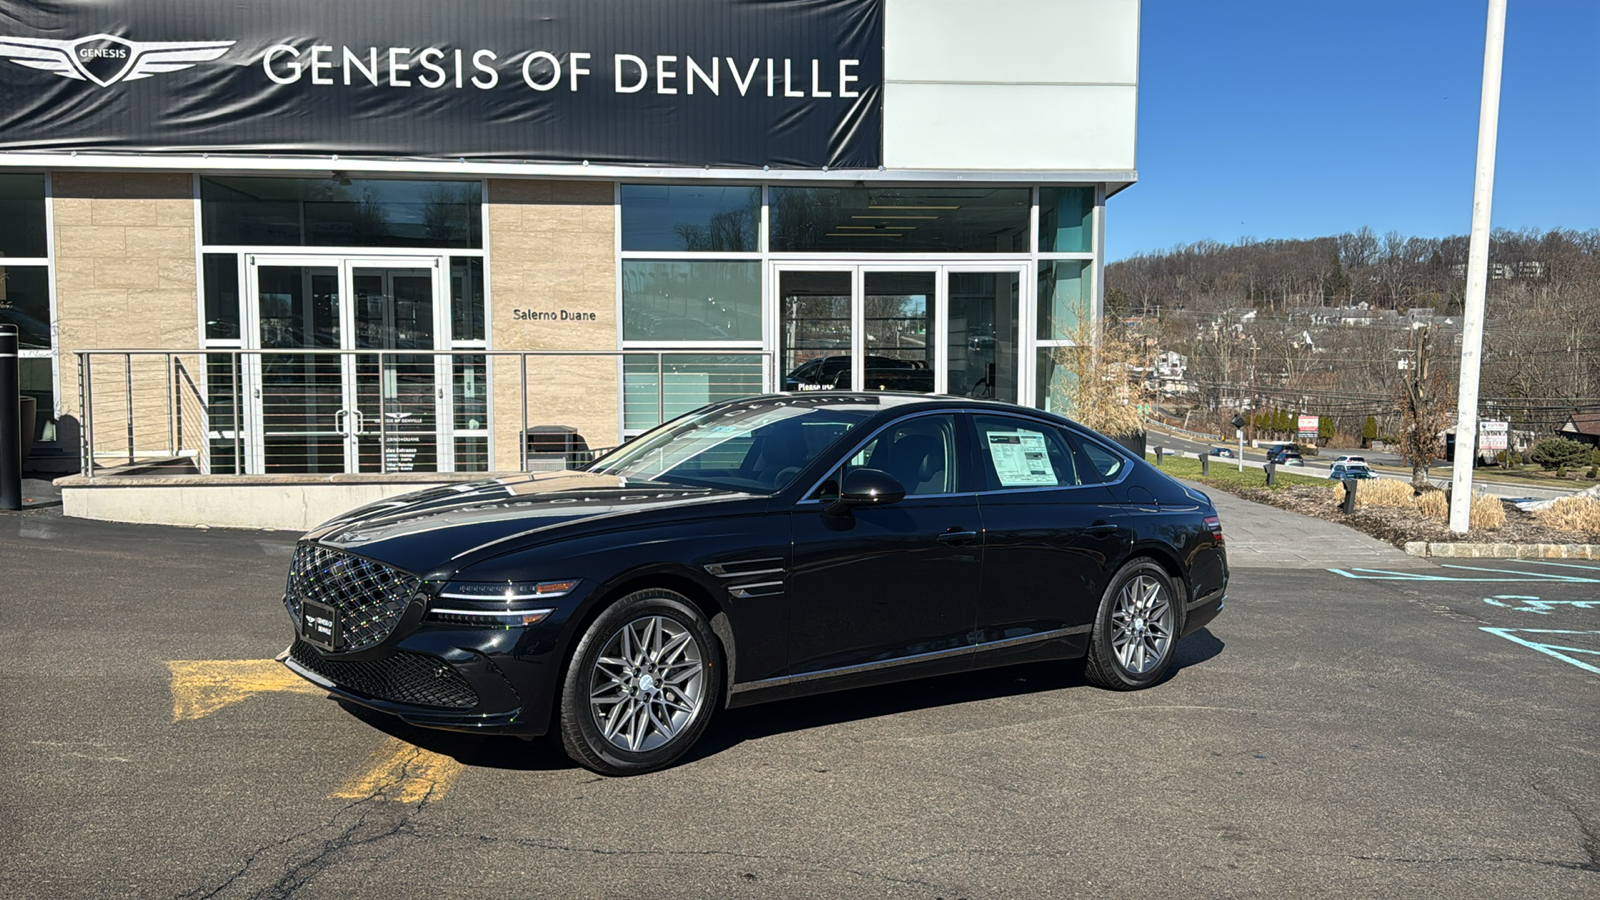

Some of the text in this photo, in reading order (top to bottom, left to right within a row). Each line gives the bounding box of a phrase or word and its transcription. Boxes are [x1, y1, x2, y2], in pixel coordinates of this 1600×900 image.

[80, 48, 126, 59] GENESIS
[262, 44, 861, 99] GENESIS OF DENVILLE
[513, 309, 596, 320] Salerno Duane
[798, 383, 821, 391] Please
